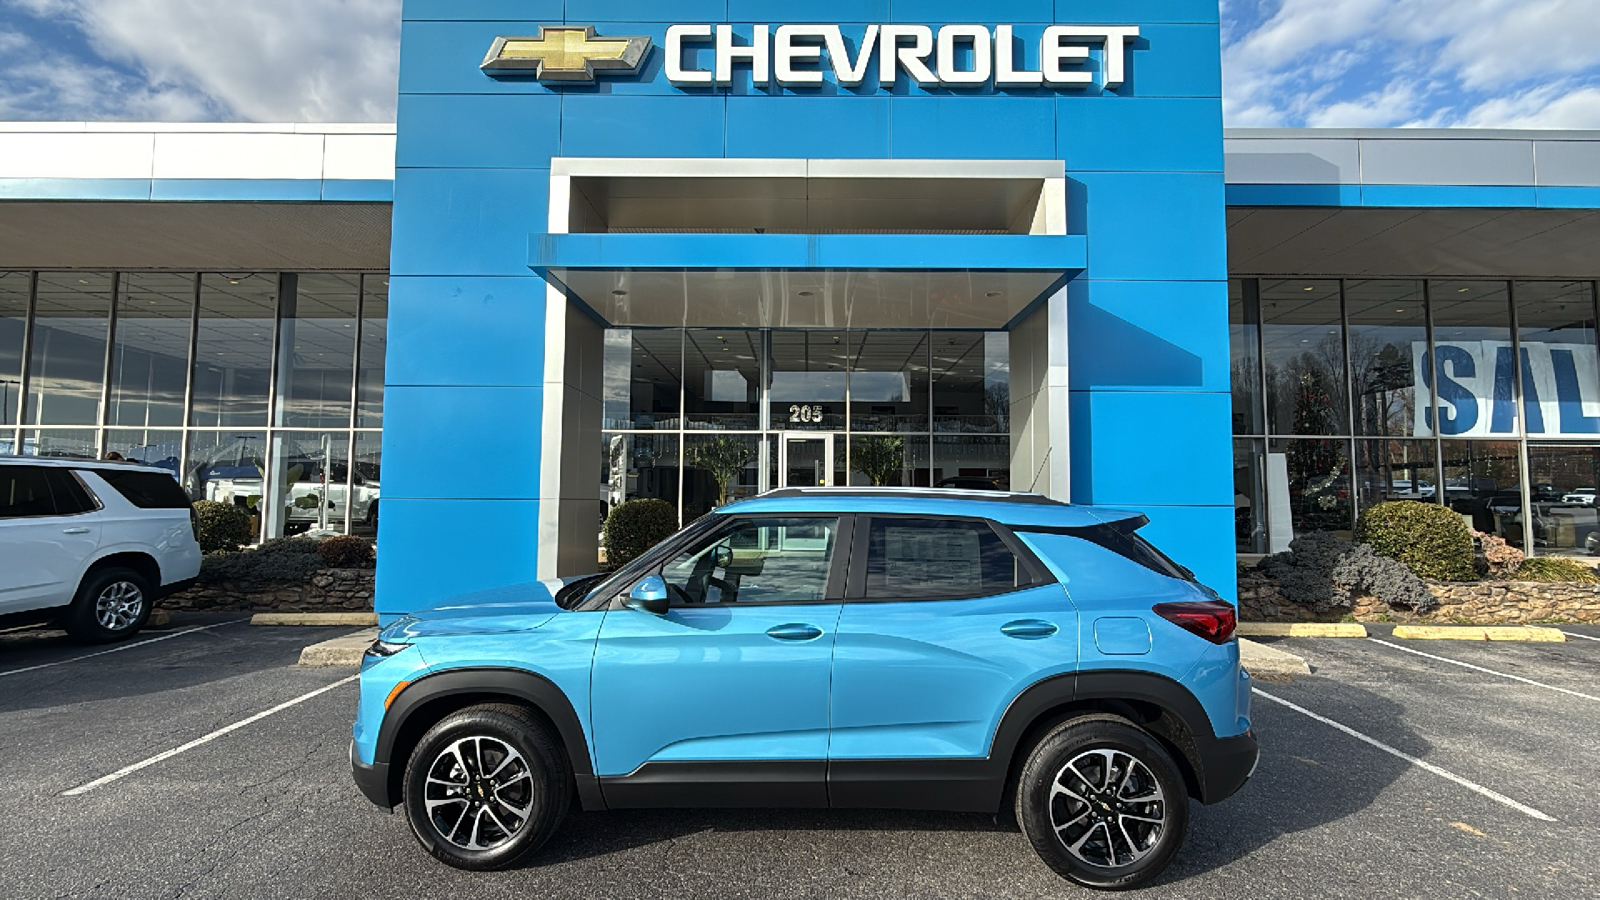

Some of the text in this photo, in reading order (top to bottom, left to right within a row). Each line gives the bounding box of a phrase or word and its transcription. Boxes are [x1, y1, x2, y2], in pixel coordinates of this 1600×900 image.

[664, 24, 1139, 88] CHEVROLET
[789, 404, 823, 424] 205
[1422, 345, 1600, 435] SAL
